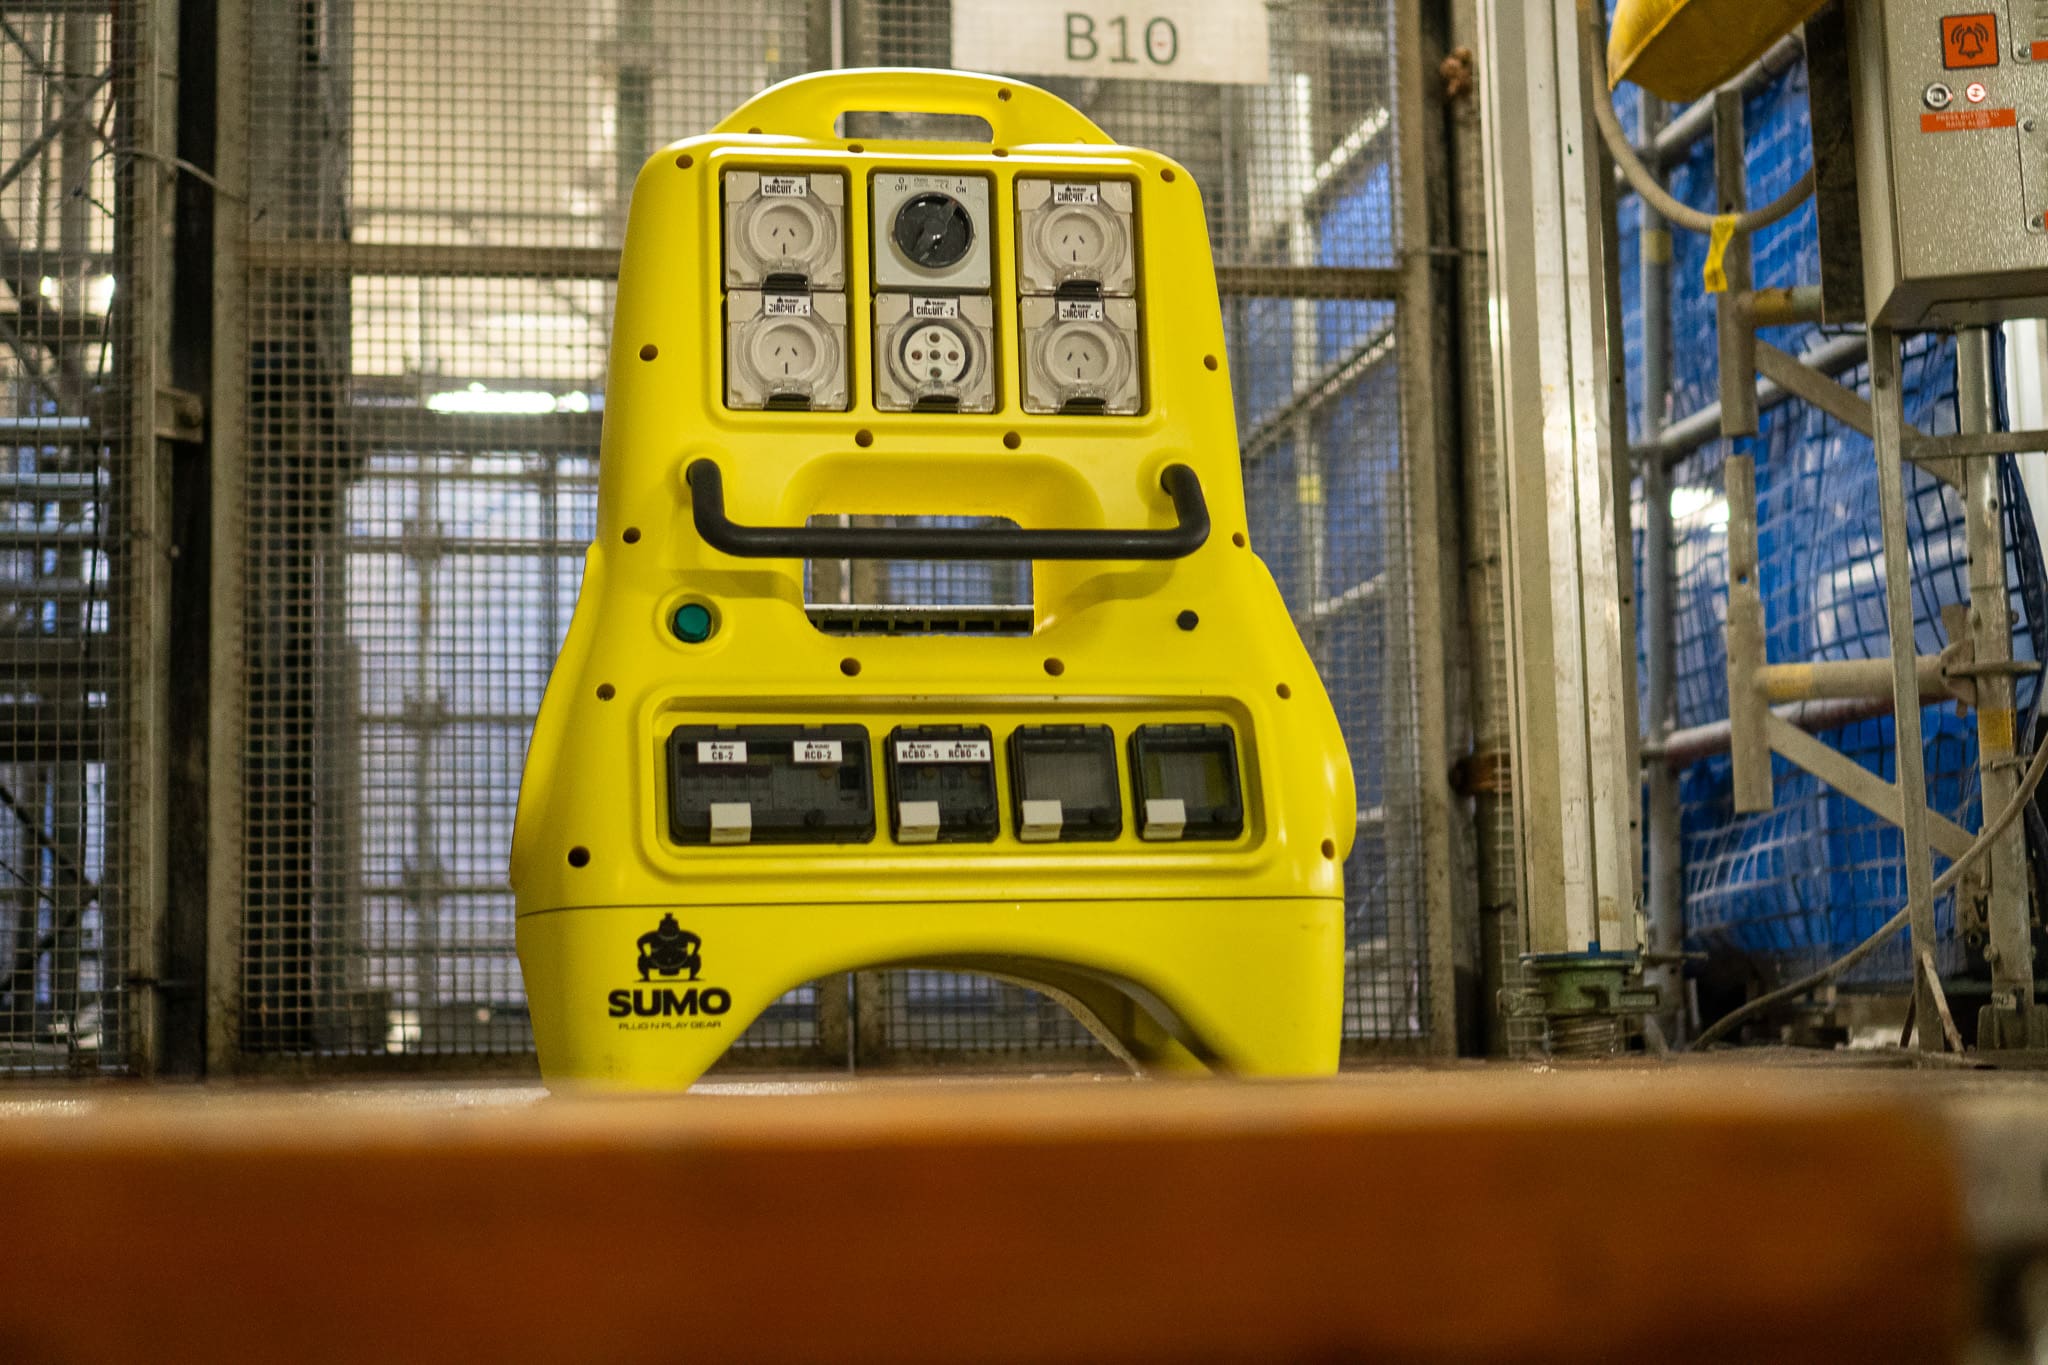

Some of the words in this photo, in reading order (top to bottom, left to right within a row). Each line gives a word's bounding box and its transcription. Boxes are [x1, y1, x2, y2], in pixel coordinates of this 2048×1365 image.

[1065, 12, 1178, 65] B10
[765, 184, 791, 194] CIRCUIT
[894, 184, 907, 192] OFF
[1057, 192, 1083, 202] CIRCUIT
[916, 306, 943, 316] CIRCUIT
[950, 307, 954, 316] 2
[902, 749, 925, 758] RCBO
[948, 749, 972, 758] RCBO
[608, 987, 731, 1018] SUMO
[619, 1021, 648, 1031] PLUG
[661, 1021, 688, 1030] PLAY
[690, 1020, 721, 1029] GEAR
